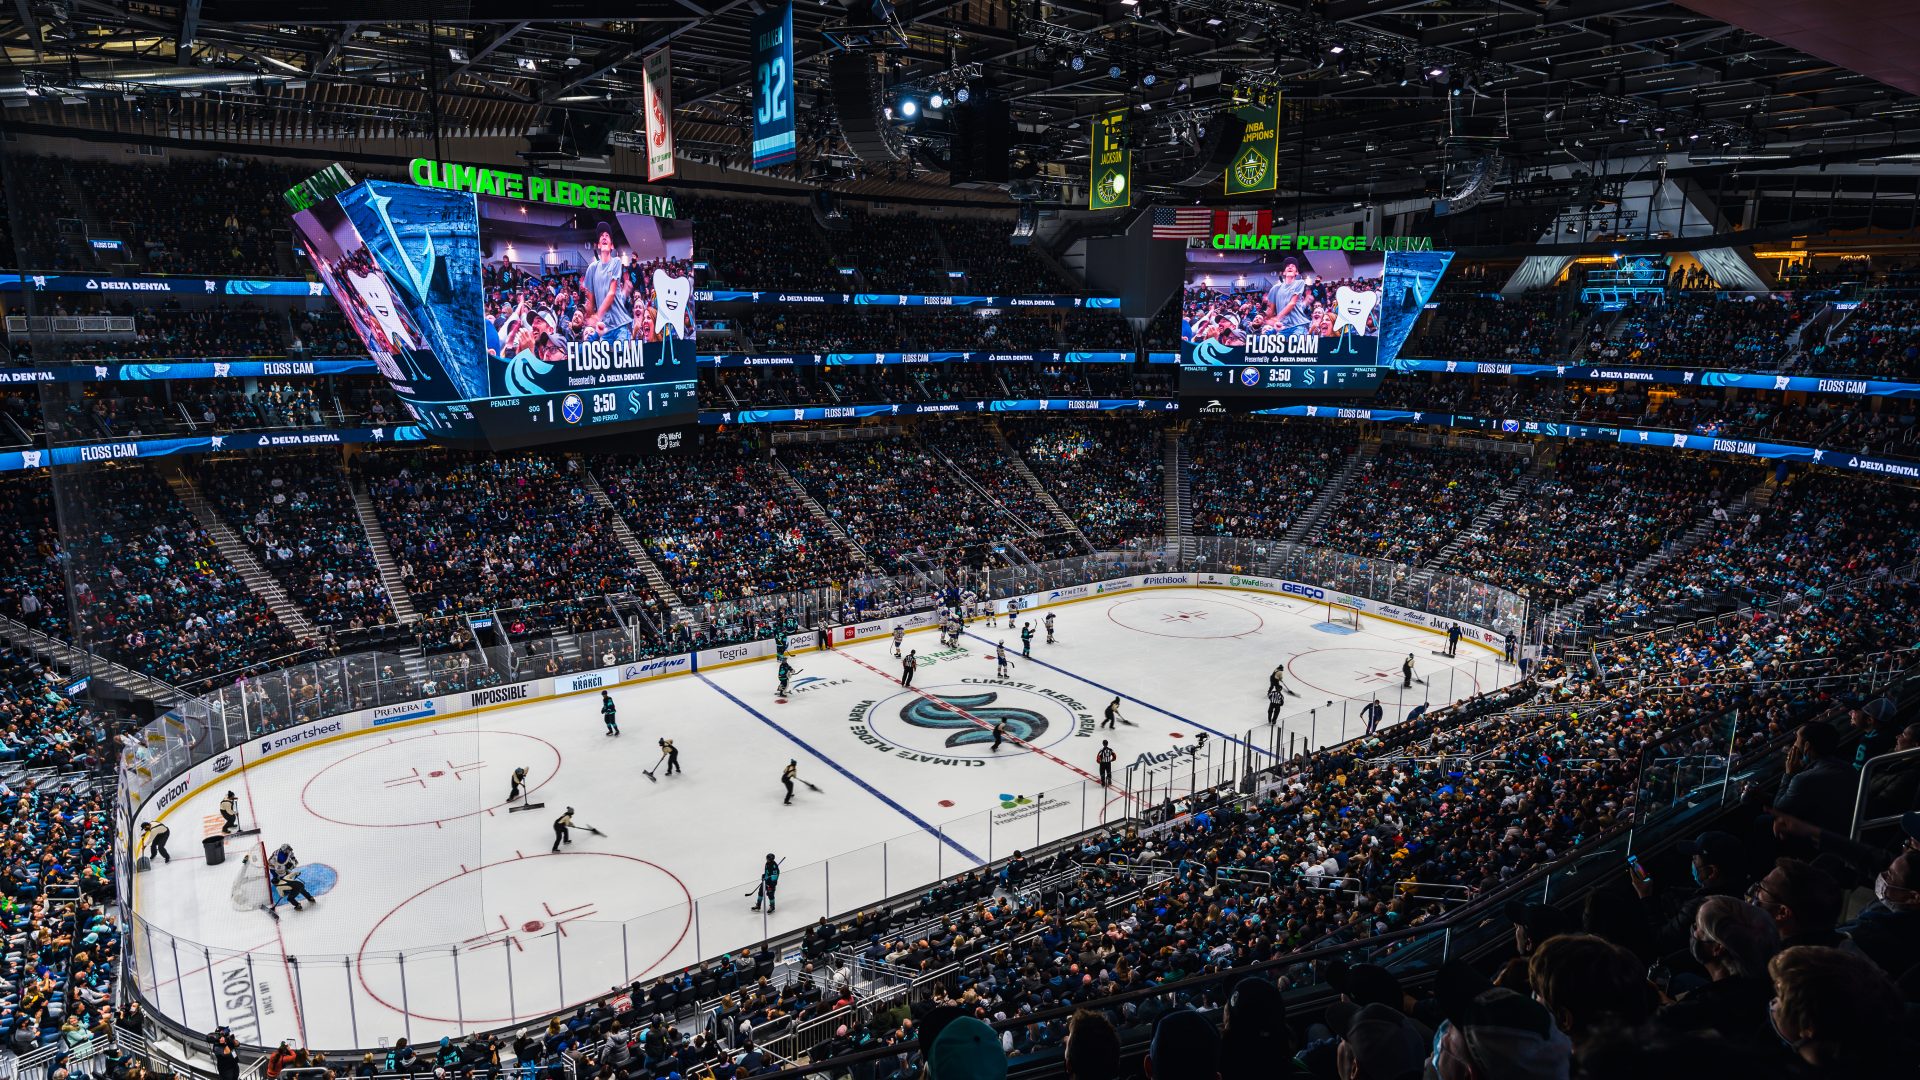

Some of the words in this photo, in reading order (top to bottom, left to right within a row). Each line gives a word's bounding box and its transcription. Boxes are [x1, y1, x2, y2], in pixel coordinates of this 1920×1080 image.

[760, 26, 783, 51] KRAKEN
[758, 56, 787, 125] 32
[1242, 129, 1274, 143] AMPIONS
[1101, 151, 1122, 165] JACKSON
[409, 158, 524, 198] CLIMATE
[527, 176, 612, 211] PLEDGE
[613, 189, 677, 219] ARENA
[1212, 234, 1291, 250] CLIMATE
[1297, 235, 1367, 250] PLEDGE
[1371, 236, 1433, 251] ARENA
[101, 281, 131, 290] DELTA
[132, 282, 171, 291] DENTAL
[700, 292, 714, 301] CAM
[924, 296, 939, 305] FLOSS
[940, 296, 952, 305] CAM
[1245, 334, 1286, 354] FLOSS
[1287, 334, 1319, 354] CAM
[567, 340, 611, 371] FLOSS
[613, 339, 644, 369] CAM
[902, 354, 917, 363] FLOSS
[917, 354, 929, 363] CAM
[1244, 355, 1263, 363] Presented
[263, 362, 292, 375] FLOSS
[293, 362, 314, 374] CAM
[1269, 368, 1291, 382] 3:50
[1477, 363, 1496, 373] FLOSS
[1496, 364, 1512, 374] CAM
[12, 371, 55, 382] DENTAL
[568, 375, 590, 386] Presented
[606, 374, 623, 383] DELTA
[623, 373, 644, 381] DENTAL
[1228, 369, 1234, 384] 1
[1323, 370, 1328, 384] 1
[1601, 371, 1623, 379] DELTA
[1623, 372, 1654, 381] DENTAL
[675, 382, 695, 390] PENALTIES
[1818, 379, 1844, 393] FLOSS
[1845, 380, 1867, 394] CAM
[490, 398, 520, 408] PENALTIES
[593, 392, 616, 413] 3:50
[647, 390, 653, 411] 1
[1068, 400, 1086, 409] FLOSS
[1086, 400, 1099, 409] CAM
[528, 405, 540, 413] SOG
[547, 399, 554, 423] 1
[824, 408, 841, 418] FLOSS
[841, 407, 855, 417] CAM
[1337, 408, 1355, 418] FLOSS
[1355, 409, 1371, 419] CAM
[602, 414, 619, 422] PERIOD
[1492, 419, 1497, 429] 1
[1525, 421, 1538, 430] 3:50
[1565, 426, 1570, 436] 1
[272, 436, 301, 444] DELTA
[302, 434, 340, 443] DENTAL
[668, 431, 682, 440] WaFd
[669, 439, 681, 448] Bank
[1713, 439, 1736, 453] FLOSS
[1737, 441, 1756, 455] CAM
[81, 445, 112, 461] FLOSS
[113, 443, 138, 458] CAM
[1860, 460, 1884, 472] DELTA
[1885, 464, 1919, 477] DENTAL
[1150, 575, 1188, 585] PitchBook
[1241, 578, 1260, 586] WaFd
[1260, 580, 1274, 588] Bank
[1060, 587, 1088, 597] SYMETRA
[1281, 582, 1325, 599] GEICO
[1379, 605, 1400, 615] Alaska
[1404, 611, 1426, 621] Alaska
[857, 625, 882, 635] TOYOTA
[1430, 617, 1450, 630] JACK
[790, 633, 814, 646] pepsi
[718, 646, 748, 661] Tegria
[640, 658, 686, 672] BOEING
[572, 677, 603, 691] KRAKEN
[785, 678, 853, 695] YMETRA
[471, 684, 528, 707] IMPOSSIBLE
[373, 704, 420, 719] PREMERA
[848, 699, 876, 722] ARENA
[960, 677, 1037, 691] CLIMATE
[1038, 687, 1087, 711] PLEDGE
[1074, 713, 1096, 738] ARENA
[274, 721, 341, 749] smartsheet
[849, 725, 895, 752] PLEDGE
[213, 756, 234, 772] NHL
[896, 750, 986, 768] CLIMATE
[1126, 744, 1196, 771] Alaska
[156, 780, 188, 811] verizon
[994, 806, 1028, 819] Virginia
[1027, 798, 1057, 809] Mason
[994, 809, 1041, 826] Franciscan
[1040, 800, 1071, 812] Health
[262, 995, 275, 1016] SINCE
[385, 1059, 396, 1070] 13
